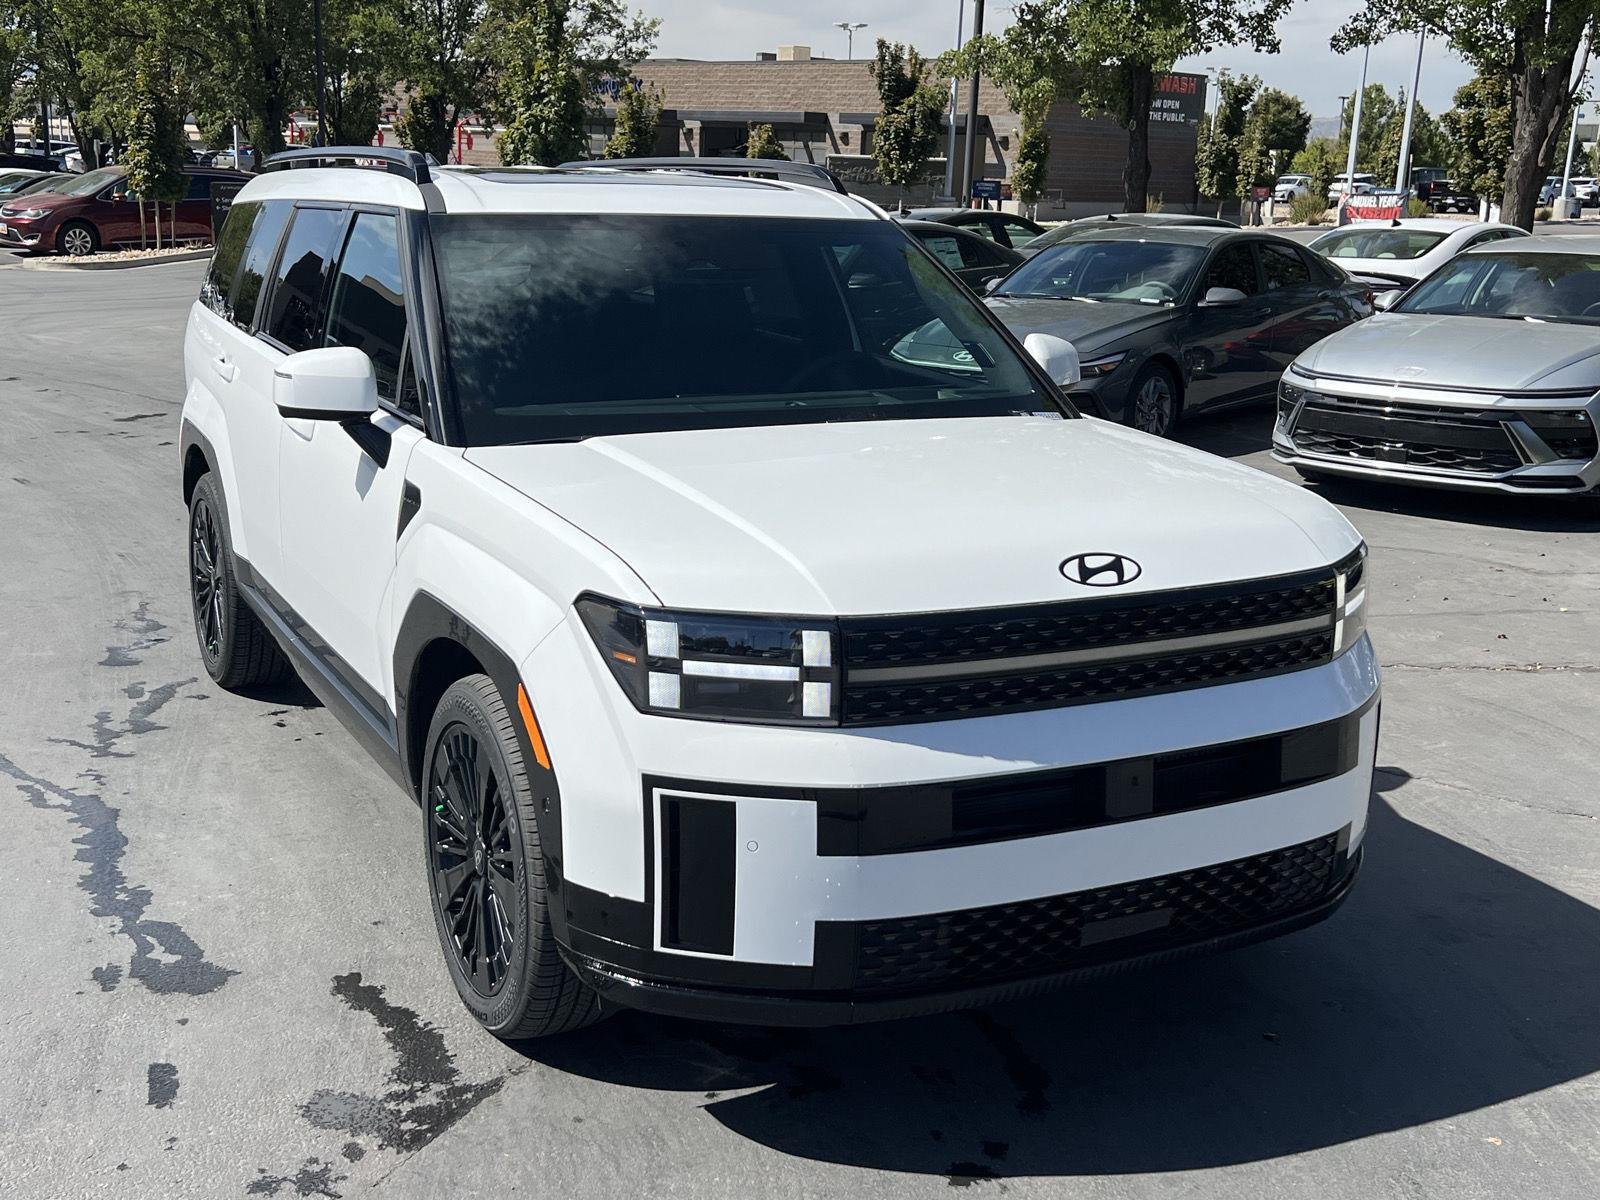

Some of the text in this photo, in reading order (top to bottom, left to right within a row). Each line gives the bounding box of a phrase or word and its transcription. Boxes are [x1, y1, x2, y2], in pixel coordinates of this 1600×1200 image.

[1160, 75, 1197, 94] WASH
[1163, 99, 1180, 109] OPEN
[1149, 111, 1185, 122] THE PUBLIC
[1353, 195, 1398, 208] MODEL YEAR
